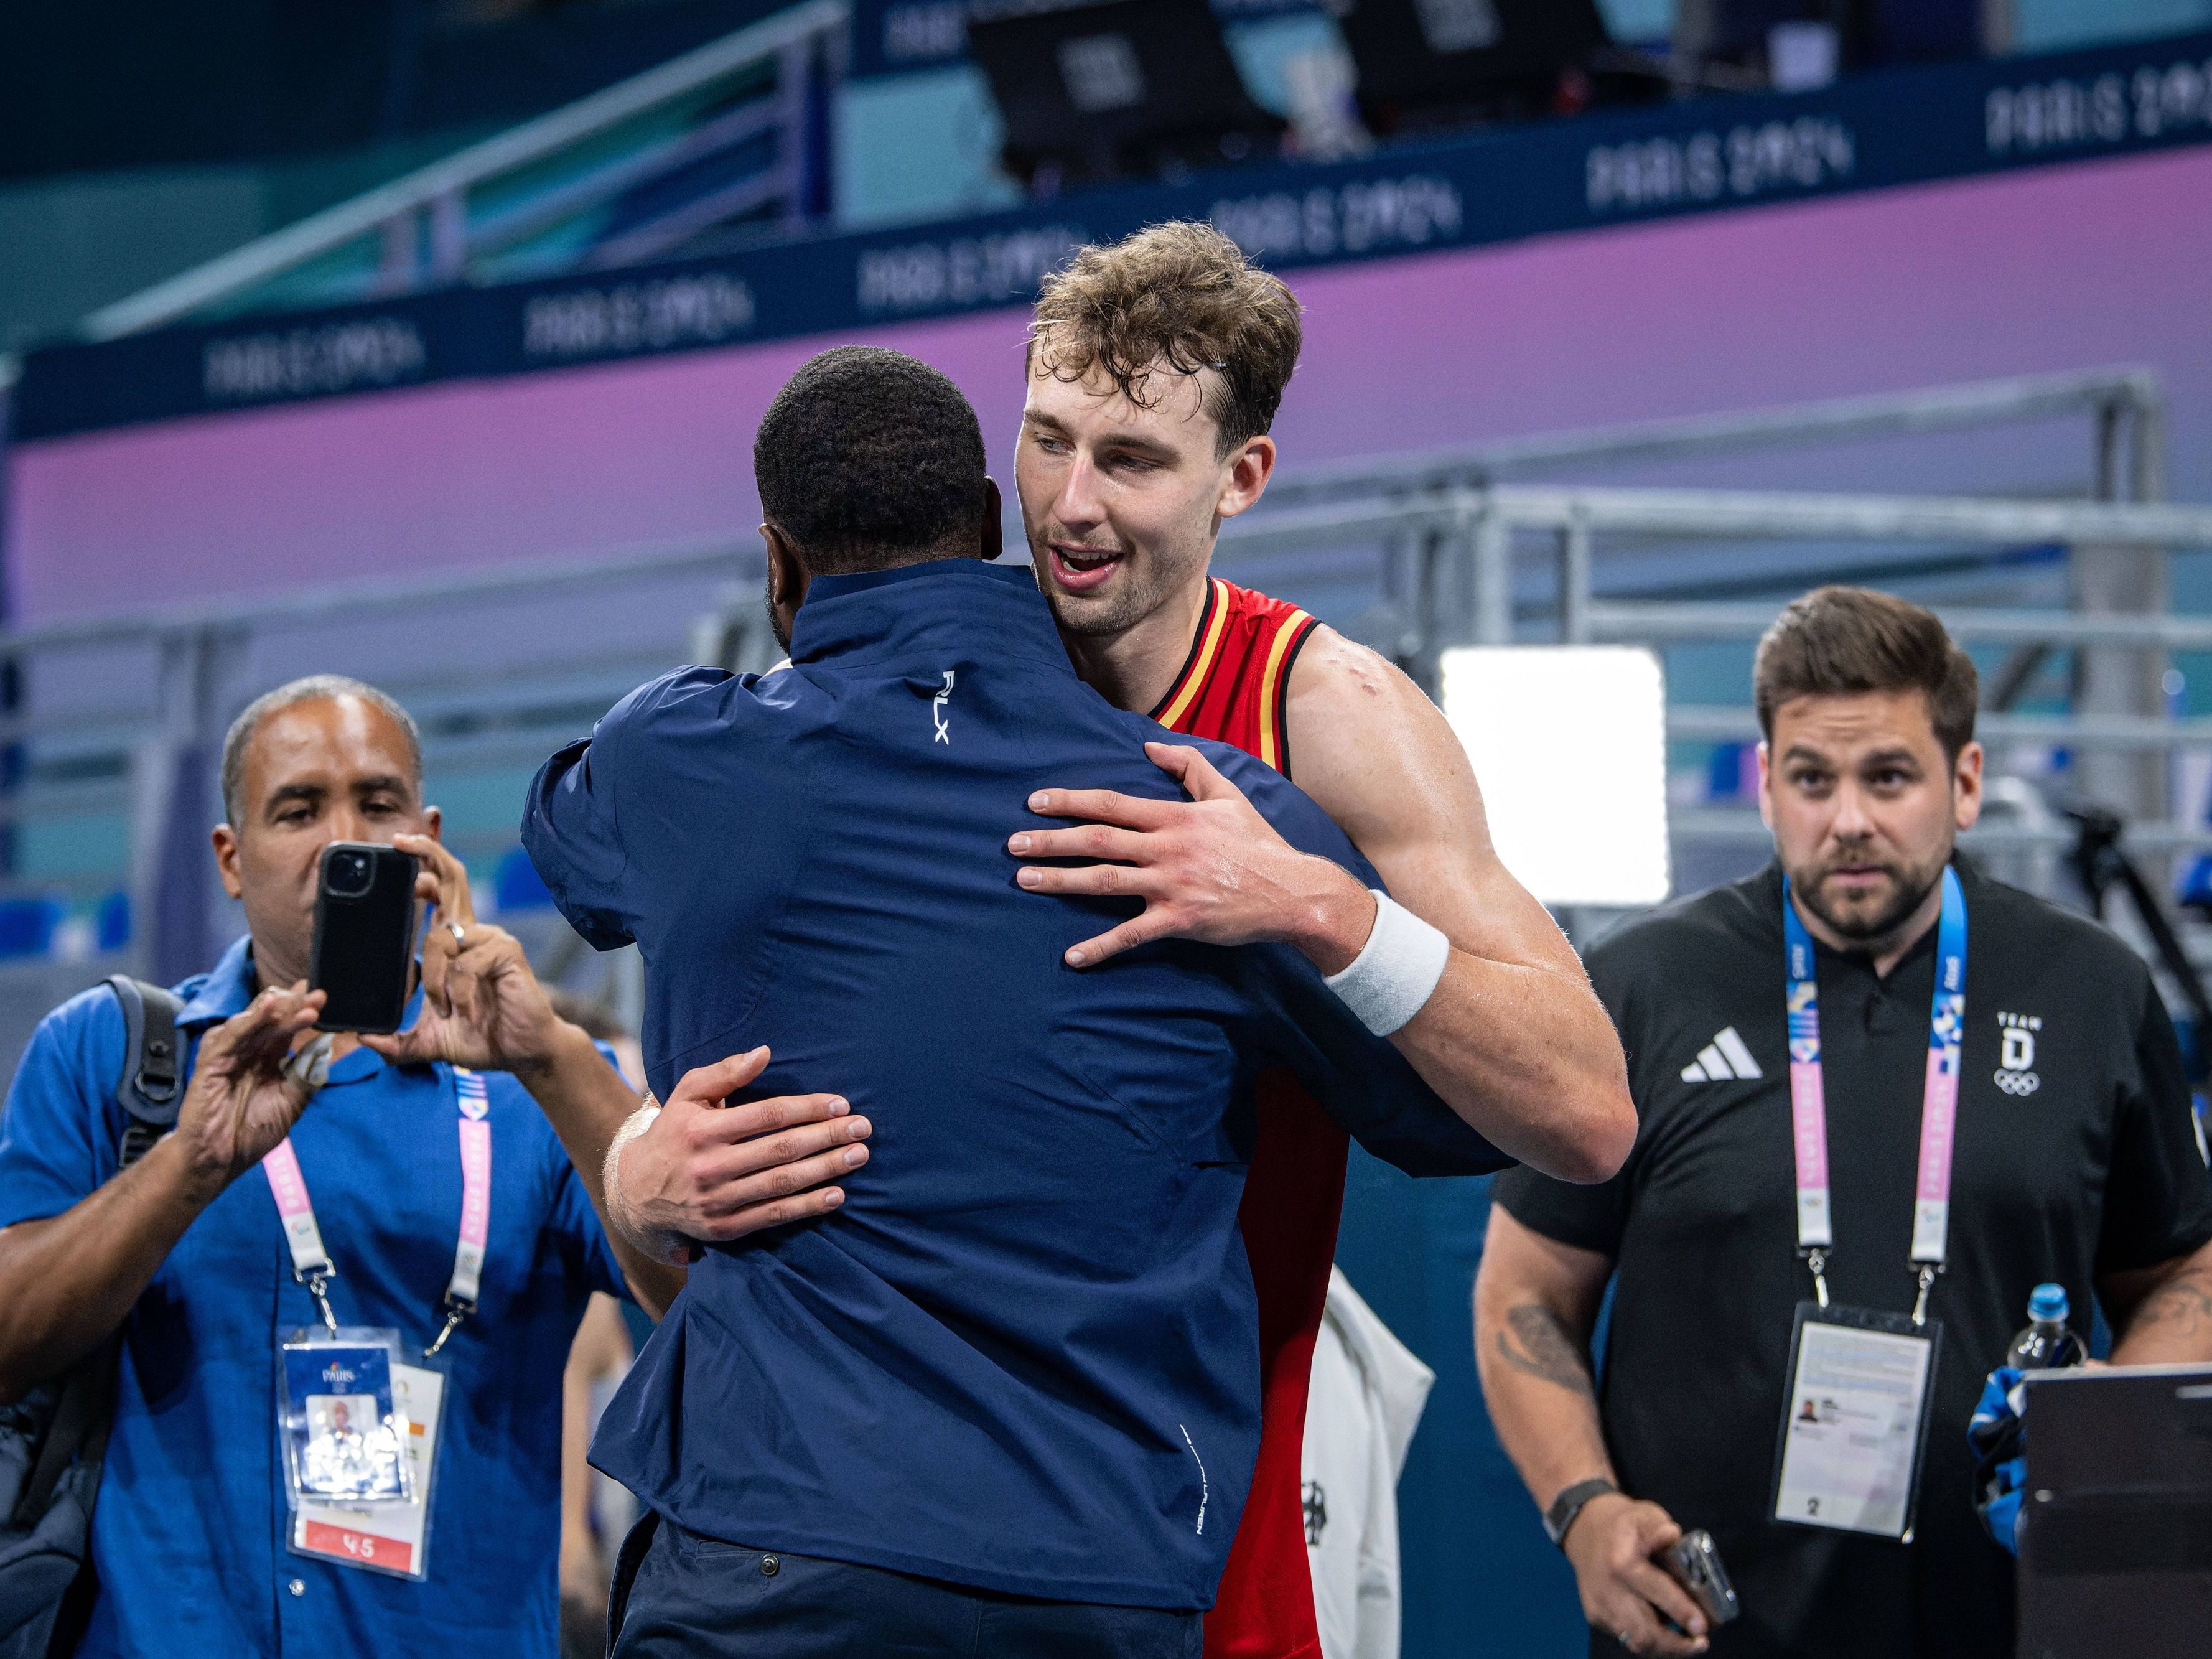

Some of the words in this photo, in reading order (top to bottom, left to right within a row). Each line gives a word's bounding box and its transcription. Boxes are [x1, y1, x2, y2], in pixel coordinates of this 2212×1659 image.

[1997, 1011, 2042, 1032] TEAM
[2001, 1027, 2035, 1071] D
[1196, 1484, 1208, 1535] LAUREN
